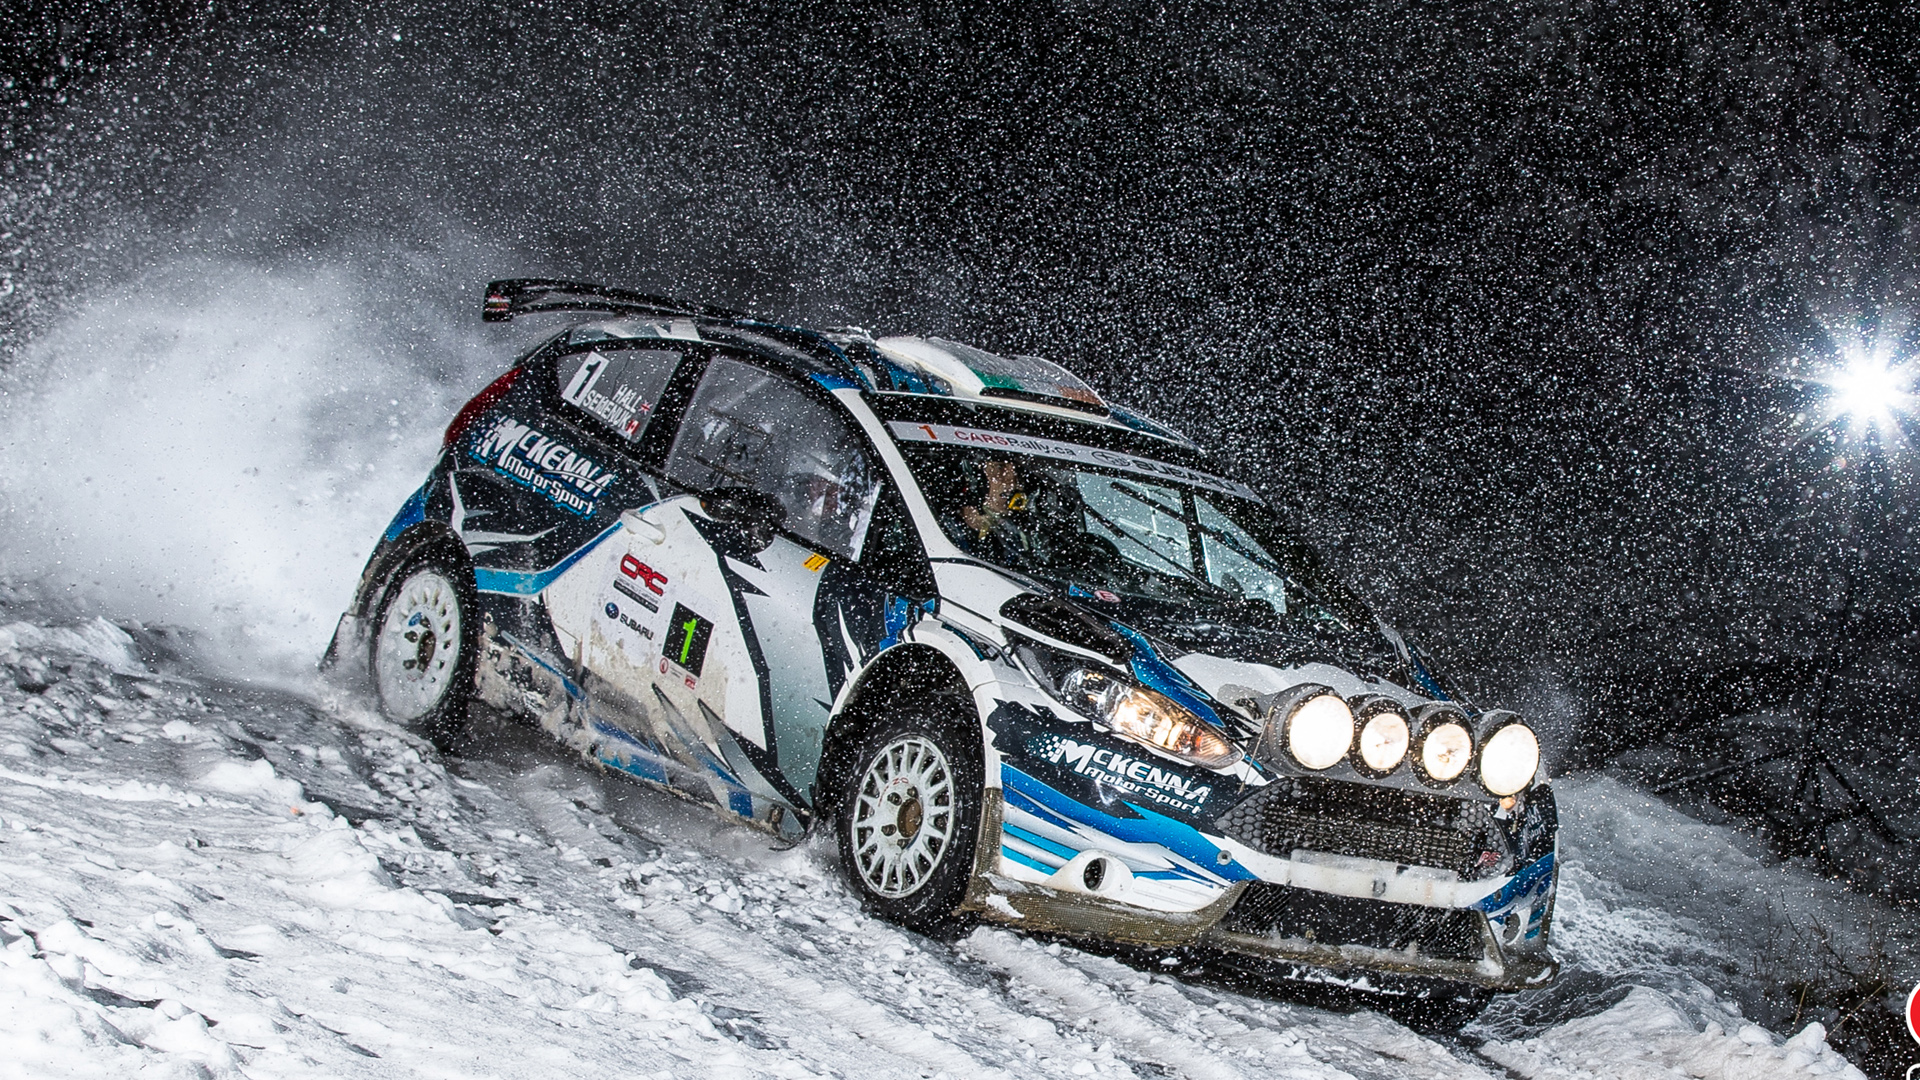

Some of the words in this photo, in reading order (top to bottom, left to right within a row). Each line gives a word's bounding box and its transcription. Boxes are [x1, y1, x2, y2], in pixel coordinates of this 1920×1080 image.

[572, 360, 602, 400] 1
[612, 384, 643, 413] HALL
[919, 425, 938, 440] 1
[619, 612, 655, 641] SUBARU
[680, 617, 698, 664] 1
